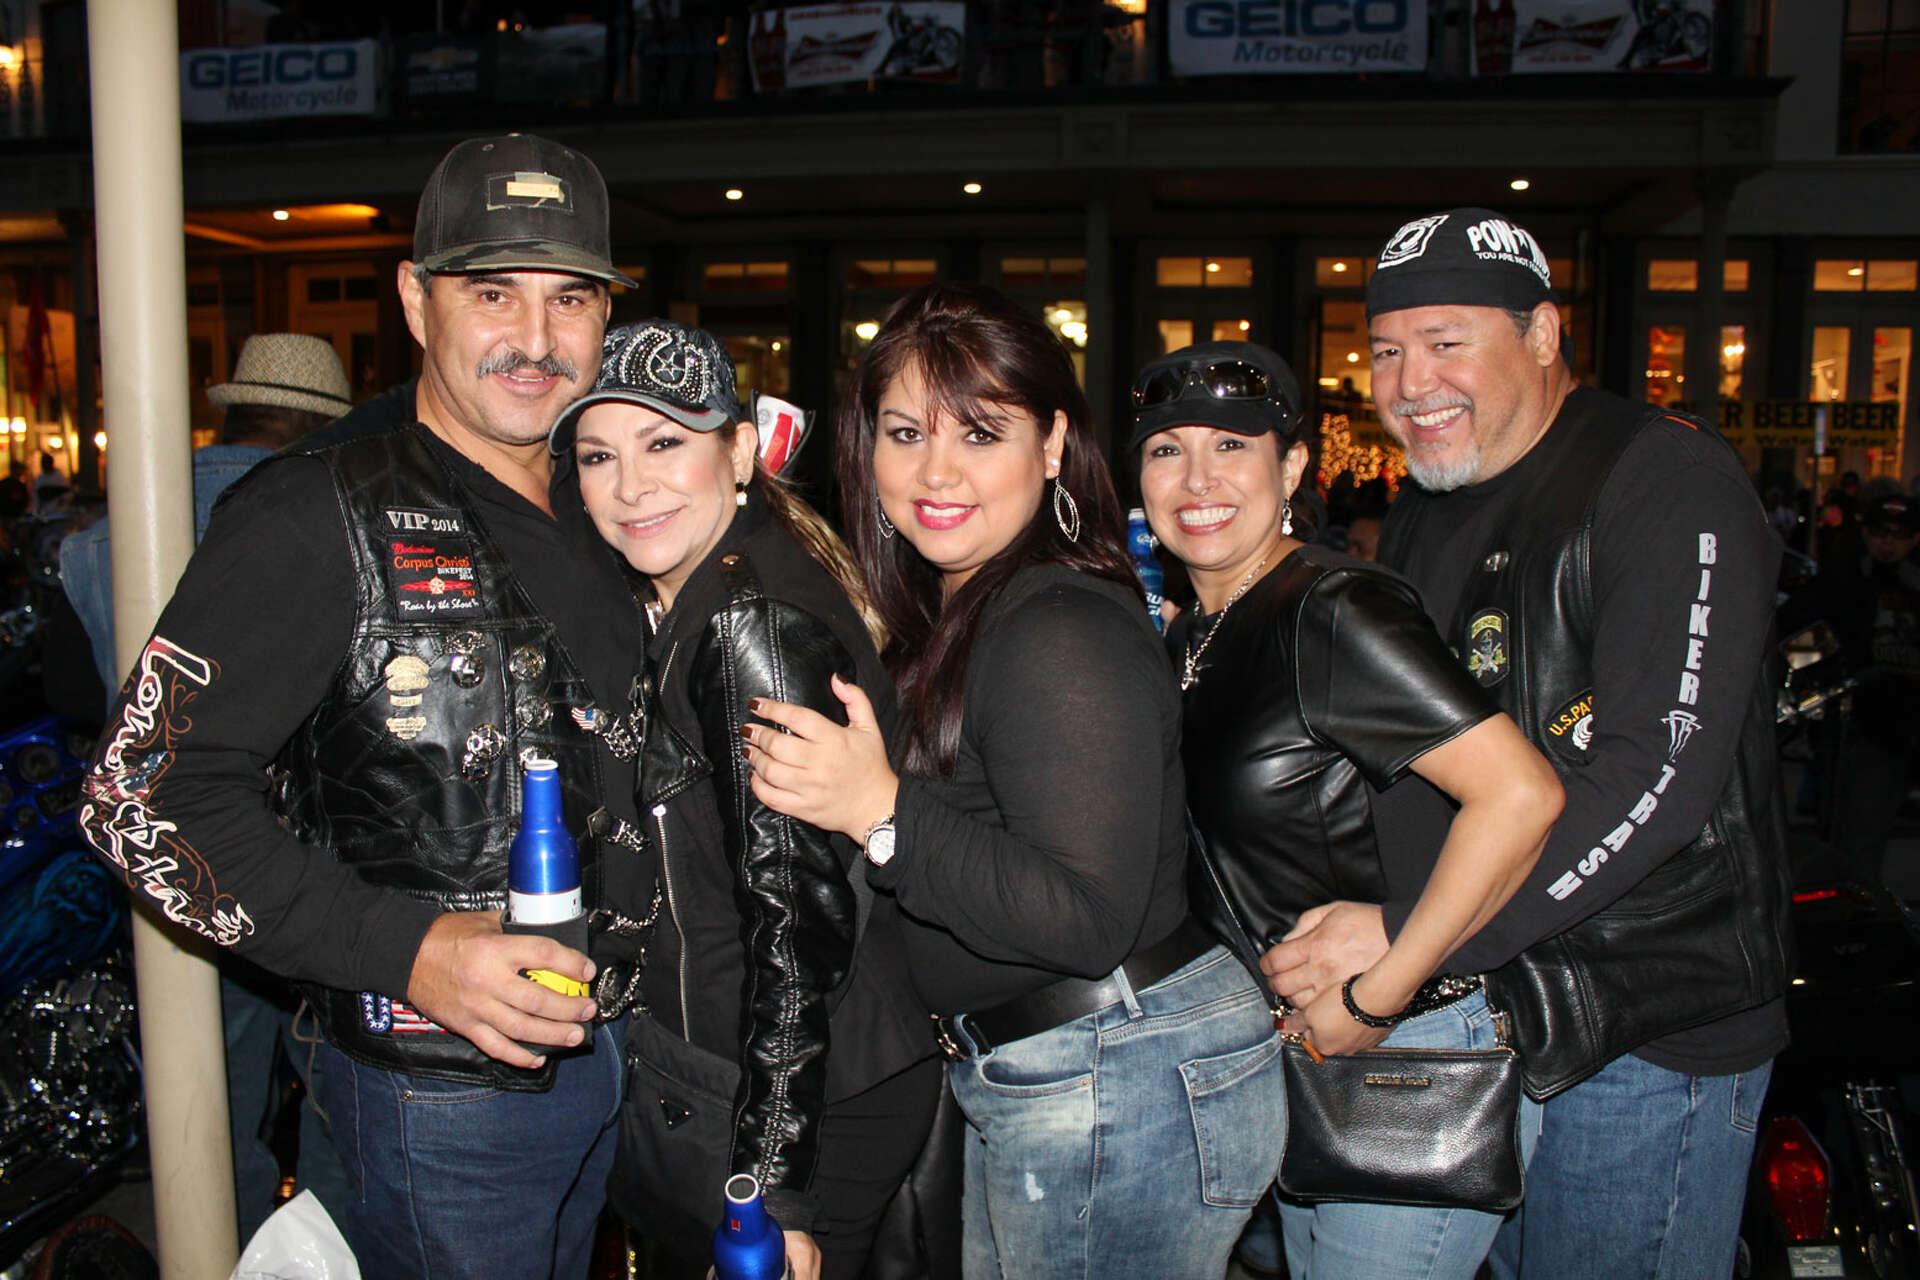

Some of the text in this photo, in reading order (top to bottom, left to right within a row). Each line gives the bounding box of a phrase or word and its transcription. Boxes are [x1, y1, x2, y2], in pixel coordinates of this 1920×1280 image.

[1186, 0, 1408, 38] GEICO
[1233, 39, 1411, 66] Motorcycle
[188, 47, 357, 89] GEICO
[227, 86, 357, 113] Motorcycle
[1832, 402, 1898, 430] BEER
[386, 510, 460, 532] VIP 2014
[394, 555, 471, 572] Corpus Christi
[426, 600, 436, 613] by
[438, 599, 450, 610] the
[1546, 532, 1718, 901] BIKER TRASH
